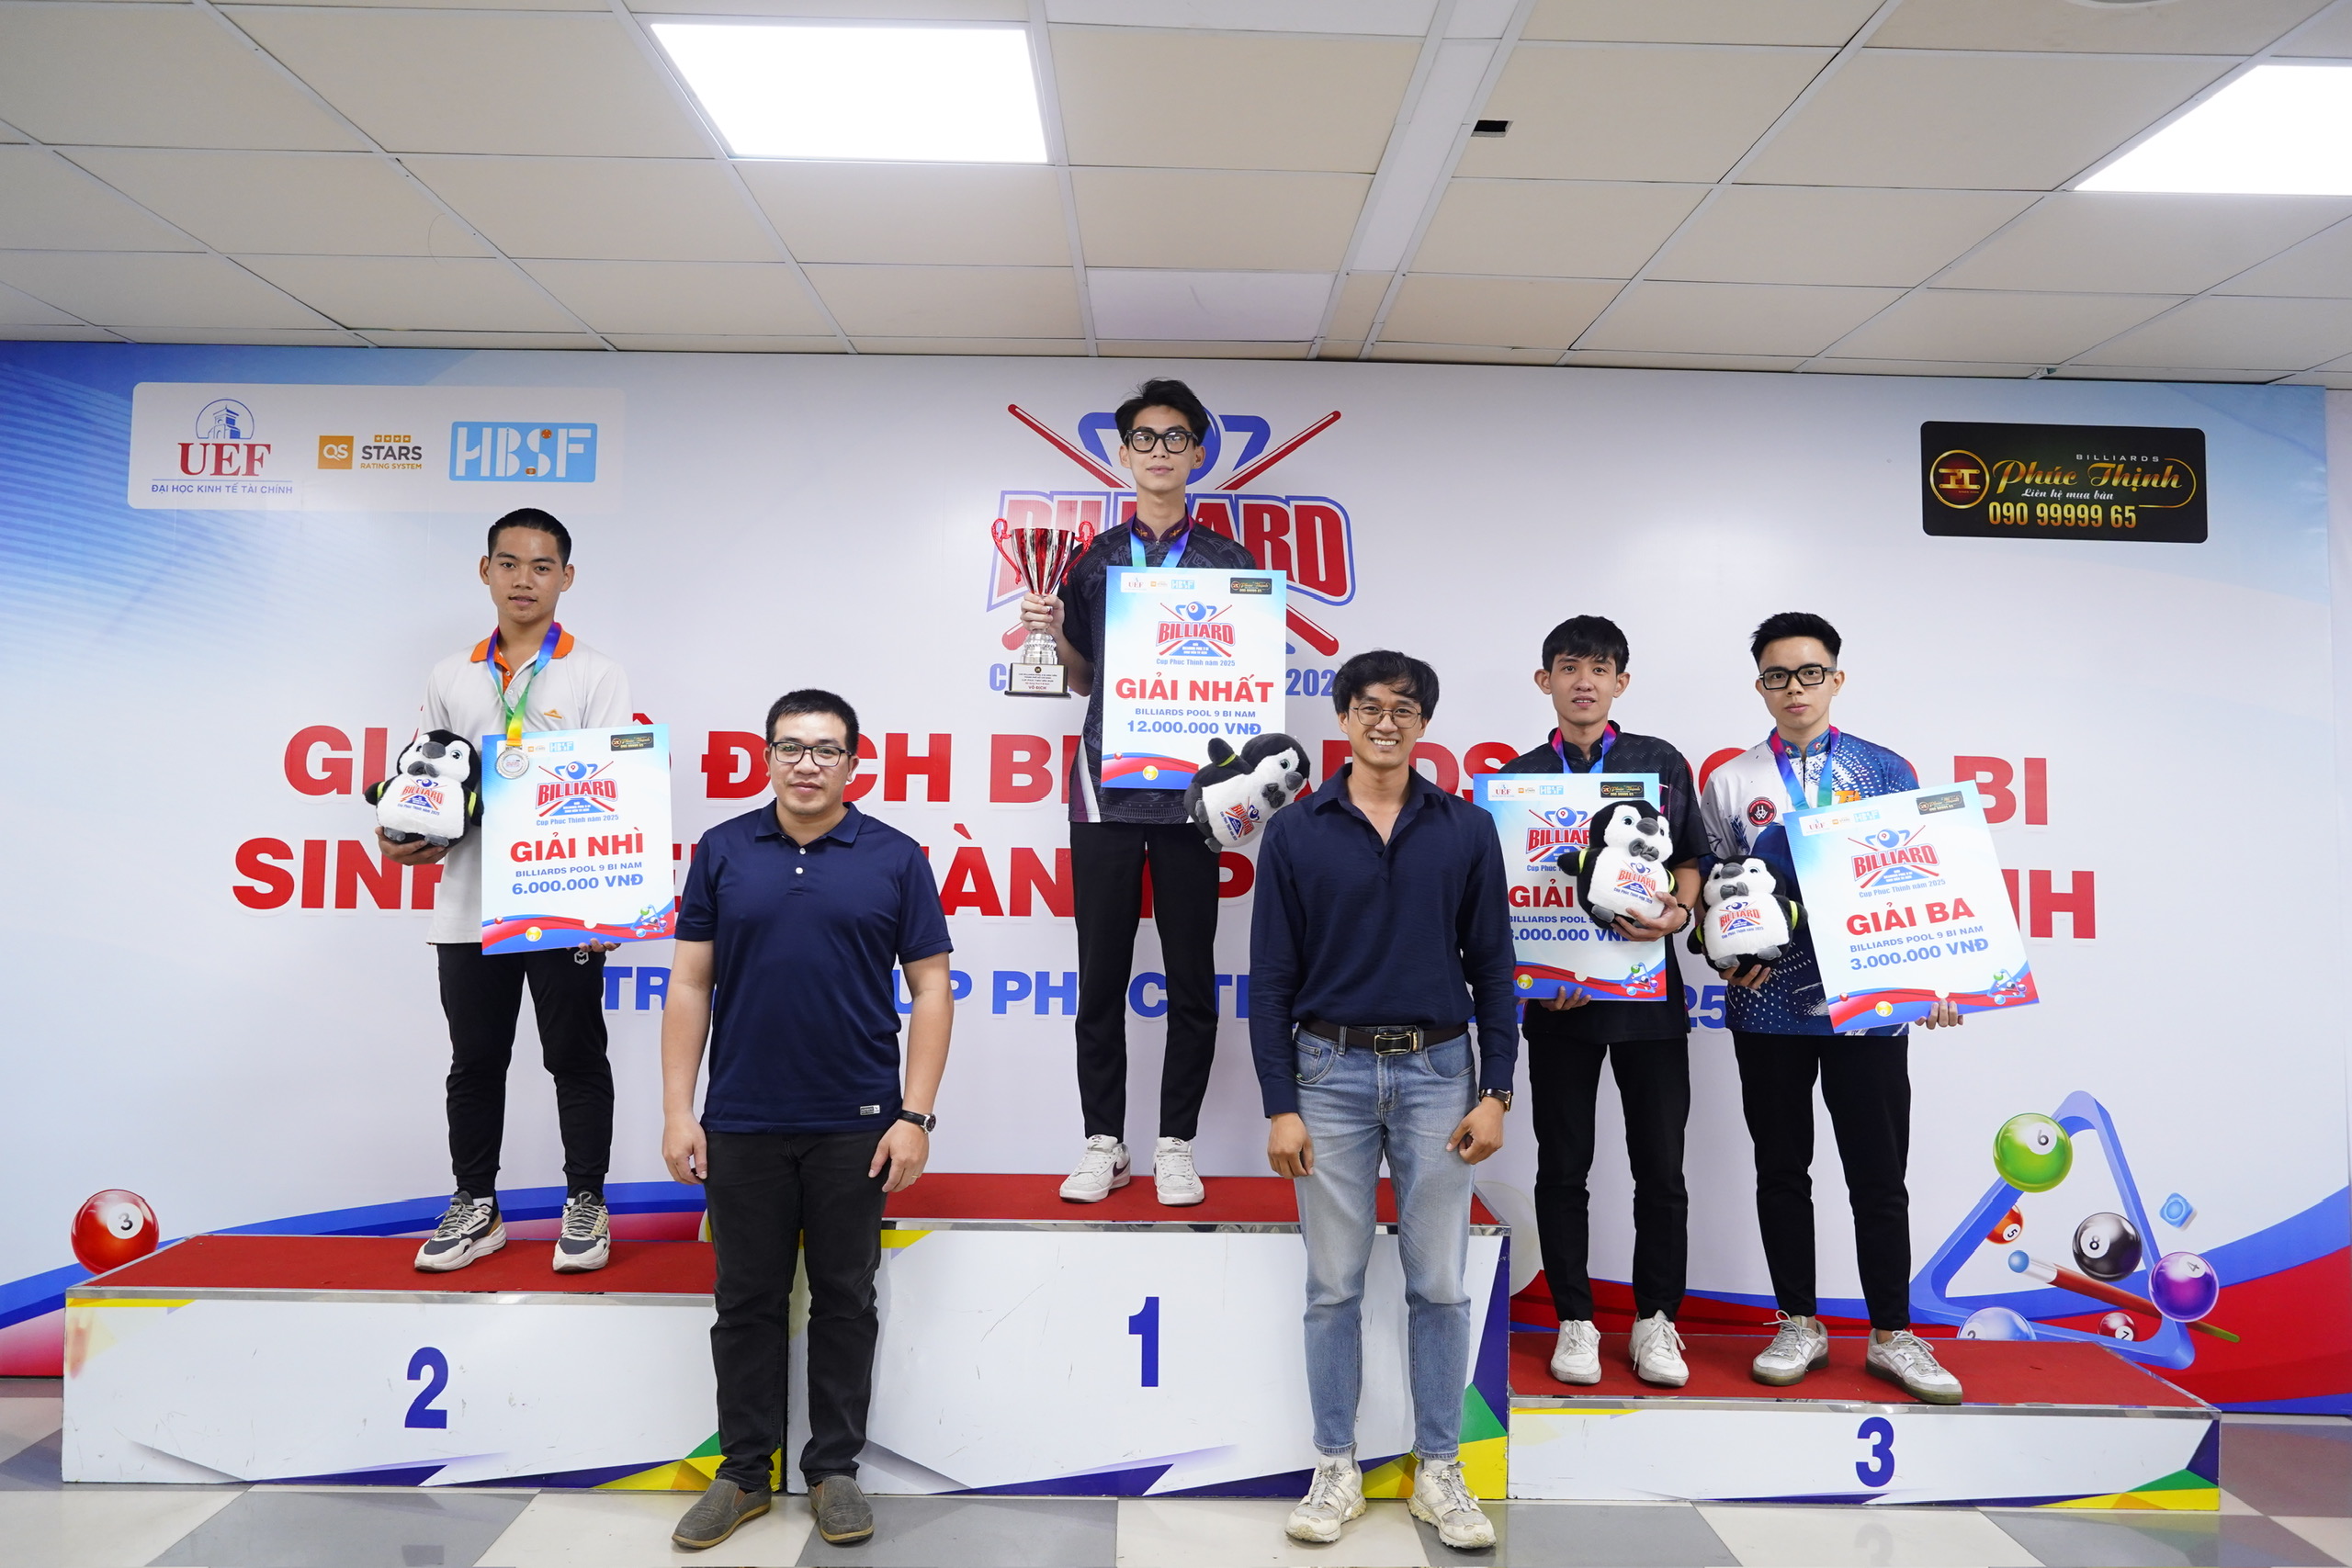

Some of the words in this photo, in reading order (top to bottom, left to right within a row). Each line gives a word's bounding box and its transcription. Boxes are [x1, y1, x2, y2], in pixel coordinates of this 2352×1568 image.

[178, 443, 271, 477] UEF
[323, 444, 349, 462] QS
[361, 446, 423, 461] STARS
[456, 427, 591, 478] HBSF
[2075, 454, 2160, 463] BILLIARDS
[1992, 459, 2078, 494] Phúc
[2087, 462, 2183, 492] Thịnh
[152, 484, 168, 495] ĐẠI
[172, 484, 194, 495] HỌC
[197, 484, 222, 494] KINH
[225, 482, 239, 494] TẾ
[242, 483, 258, 494] TÀI
[260, 483, 293, 495] CHÍNH
[2066, 491, 2090, 500] mua
[1988, 502, 2029, 525] 090
[2036, 502, 2103, 528] 99999
[2110, 505, 2137, 529] 65
[1158, 623, 1234, 645] BILLIARD
[1115, 671, 1179, 701] GIẢI
[1189, 673, 1274, 703] NHẤT
[1285, 669, 1337, 696] 202
[1135, 707, 1183, 716] BILLIARDS
[1186, 709, 1212, 717] POOL
[1127, 719, 1219, 735] 12.000.000
[1225, 722, 1261, 736] VNĐ
[401, 785, 444, 805] BILLIARD
[537, 780, 616, 807] BILLIARD
[510, 831, 576, 863] GIẢI
[588, 827, 643, 857] NHÌ
[1528, 829, 1590, 852] BILLIAR
[515, 867, 567, 878] BILLIARDS
[570, 864, 596, 874] POOL
[598, 863, 605, 872] 9
[620, 862, 642, 870] NAM
[1853, 845, 1938, 878] BILLIARD
[512, 877, 599, 895] 6.000.000
[605, 874, 643, 887] VNĐ
[1618, 870, 1656, 891] BILLIARD
[1928, 879, 1946, 887] 2025
[1509, 878, 1574, 908] GIẢI
[1560, 916, 1587, 924] POOL
[1719, 909, 1760, 928] BILLIARD
[1847, 901, 1917, 936] GIẢI
[1925, 897, 1975, 924] BA
[1849, 938, 1904, 953] BILLIARDS
[1905, 932, 1935, 944] POOL
[1946, 929, 1957, 938] BI
[1959, 925, 1984, 935] NAM
[1850, 945, 1941, 971] 3.000.000
[1945, 938, 1989, 956] VNĐ
[2037, 1129, 2050, 1146] 6
[119, 1213, 133, 1231] 3
[2007, 1227, 2018, 1239] 5
[2089, 1235, 2100, 1250] 8
[2187, 1260, 2200, 1273] 4
[1128, 1296, 1159, 1388] 1
[2120, 1330, 2132, 1340] 7
[404, 1347, 449, 1429] 2
[1855, 1416, 1895, 1488] 3
